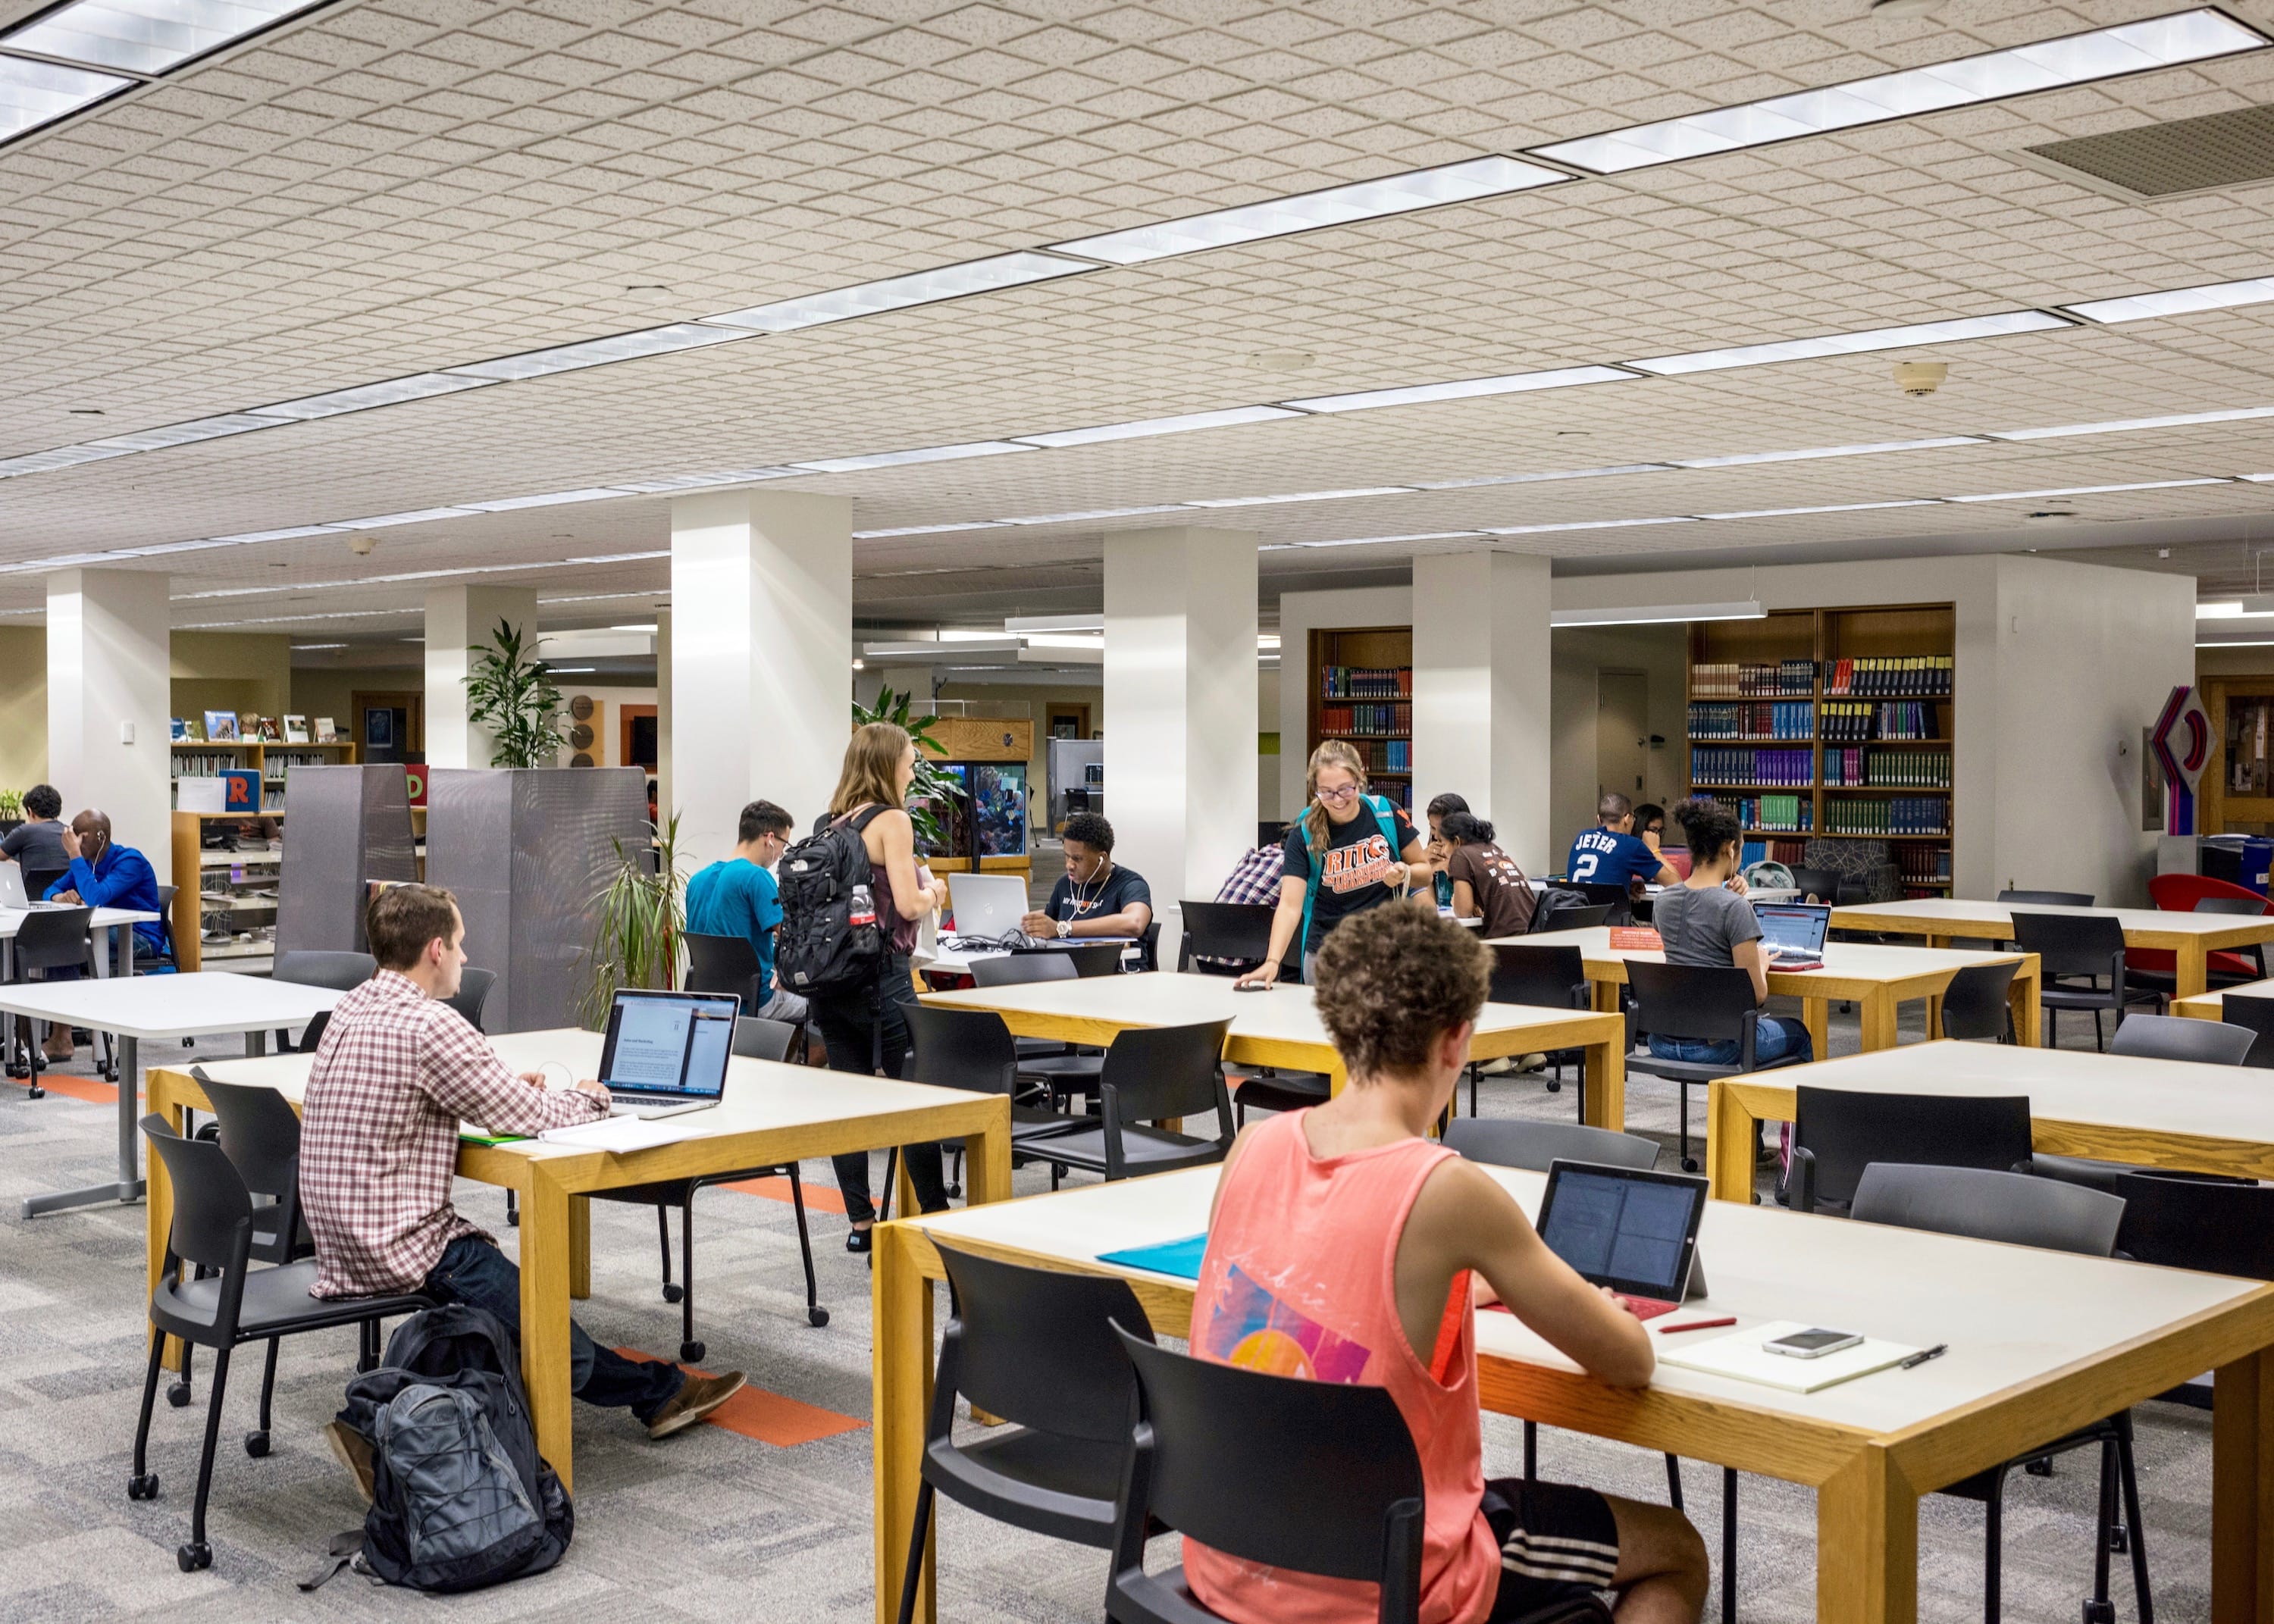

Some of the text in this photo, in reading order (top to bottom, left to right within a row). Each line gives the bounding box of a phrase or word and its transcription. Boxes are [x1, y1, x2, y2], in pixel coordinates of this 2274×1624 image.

[228, 776, 249, 803] R
[407, 774, 424, 799] D
[1576, 834, 1617, 854] JETER
[1325, 842, 1368, 875] RIT
[1572, 854, 1599, 884] 2
